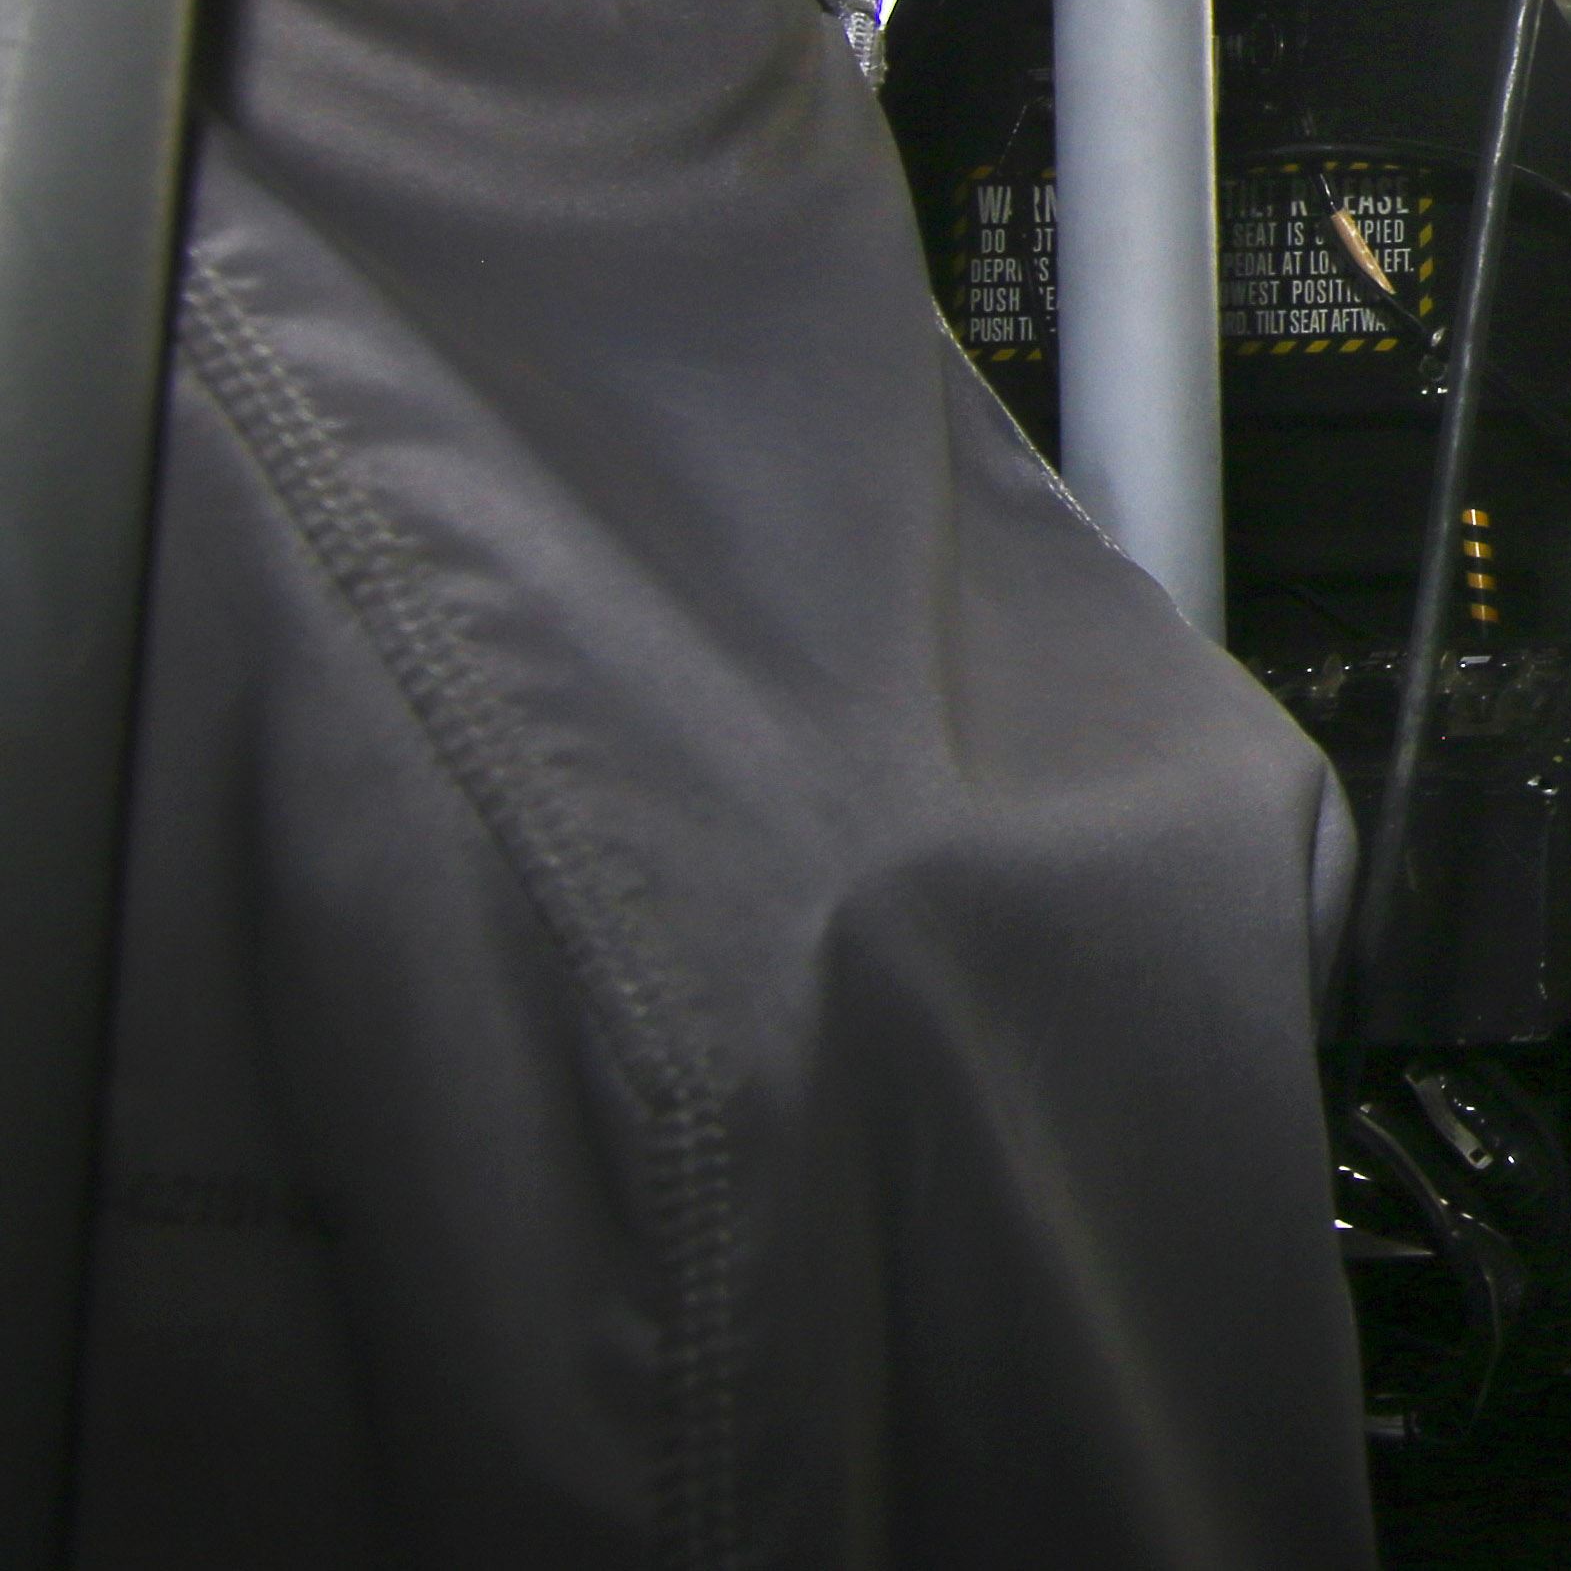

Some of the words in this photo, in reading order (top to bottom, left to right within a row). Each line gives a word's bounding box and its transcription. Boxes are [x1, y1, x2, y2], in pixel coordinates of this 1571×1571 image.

[981, 228, 1006, 254] DO
[1287, 221, 1304, 246] IS
[1282, 251, 1303, 275] AT
[970, 286, 1020, 313] PUSH
[970, 316, 1014, 343] PUSH
[1257, 310, 1287, 335] TILT
[1290, 308, 1328, 334] SEAT
